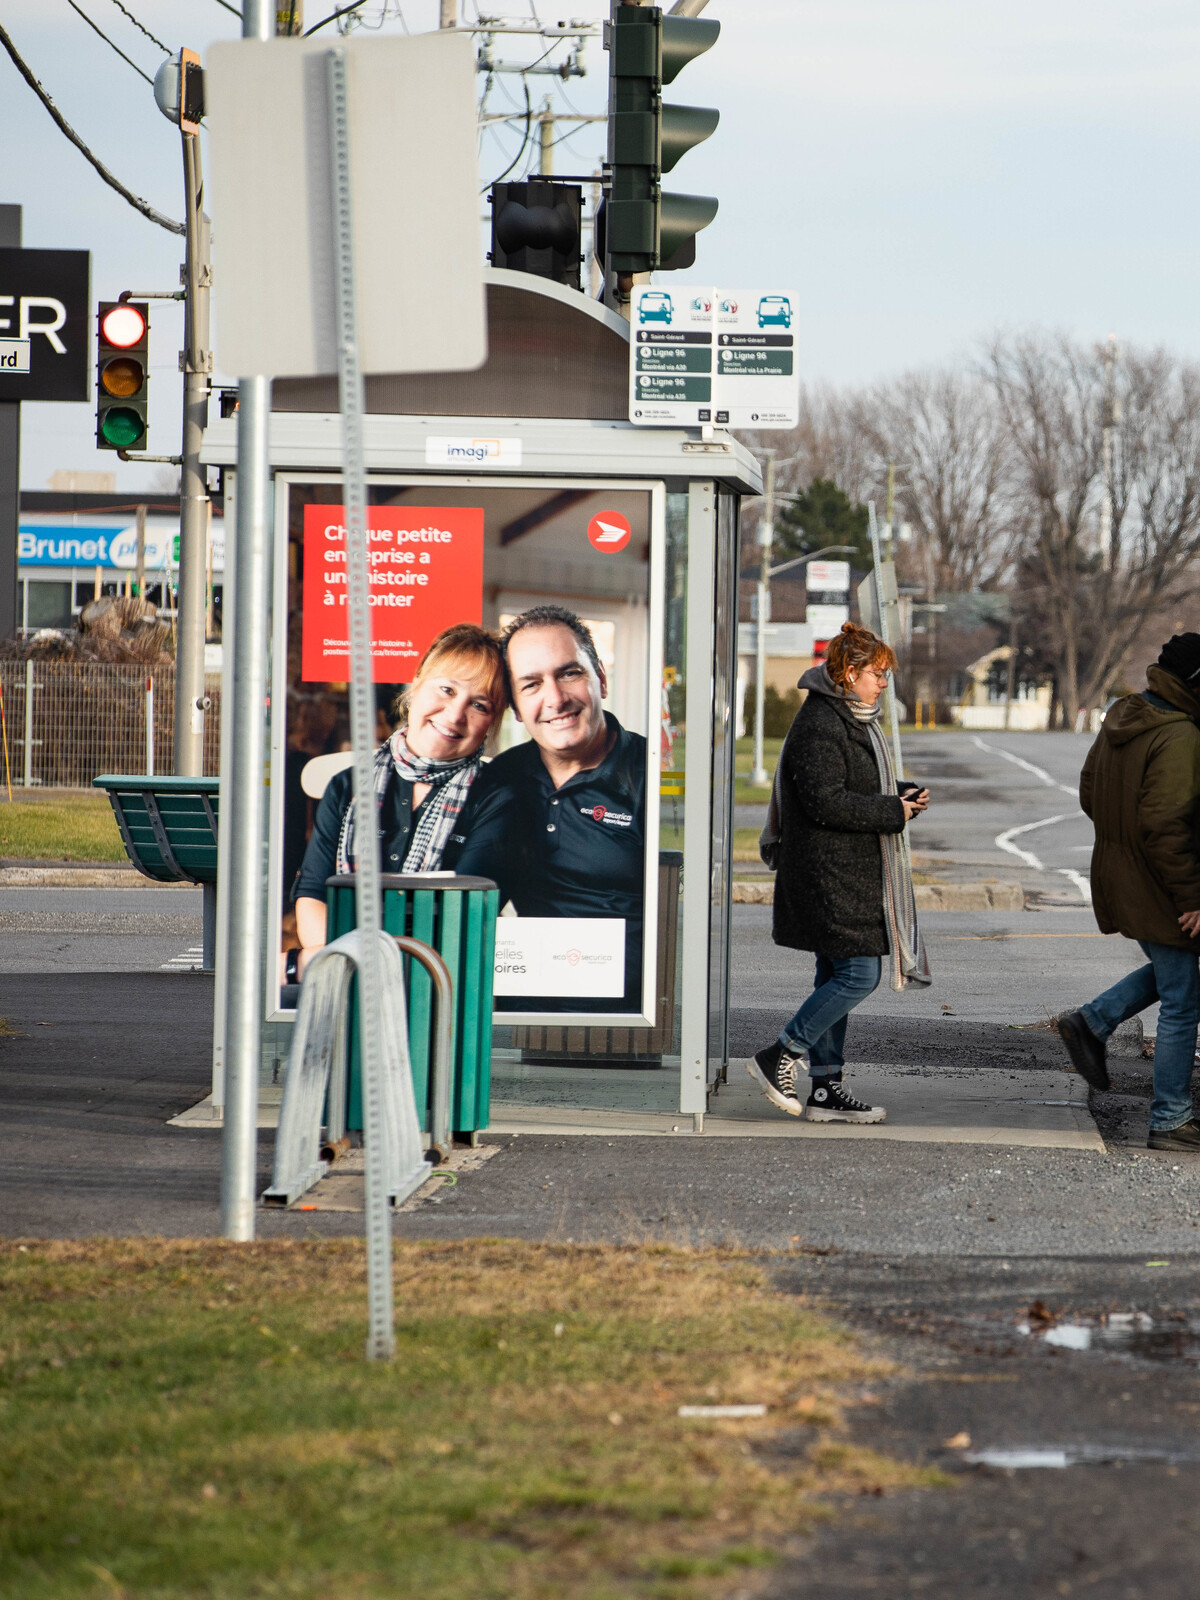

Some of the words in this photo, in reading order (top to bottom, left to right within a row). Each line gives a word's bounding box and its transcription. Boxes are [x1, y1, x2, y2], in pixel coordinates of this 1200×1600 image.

[652, 348, 674, 358] Ligne
[675, 349, 686, 357] 96
[734, 352, 756, 361] Ligne
[756, 352, 767, 360] 96
[652, 378, 673, 387] Ligne
[674, 378, 685, 386] 96
[447, 444, 488, 460] imagi
[324, 525, 393, 544] Chue
[397, 527, 452, 545] petite
[19, 532, 108, 561] Brunet
[323, 548, 415, 566] eneprise
[419, 552, 430, 563] a
[324, 572, 350, 583] un
[323, 589, 335, 605] à
[339, 592, 414, 606] ronter
[494, 962, 526, 974] oires
